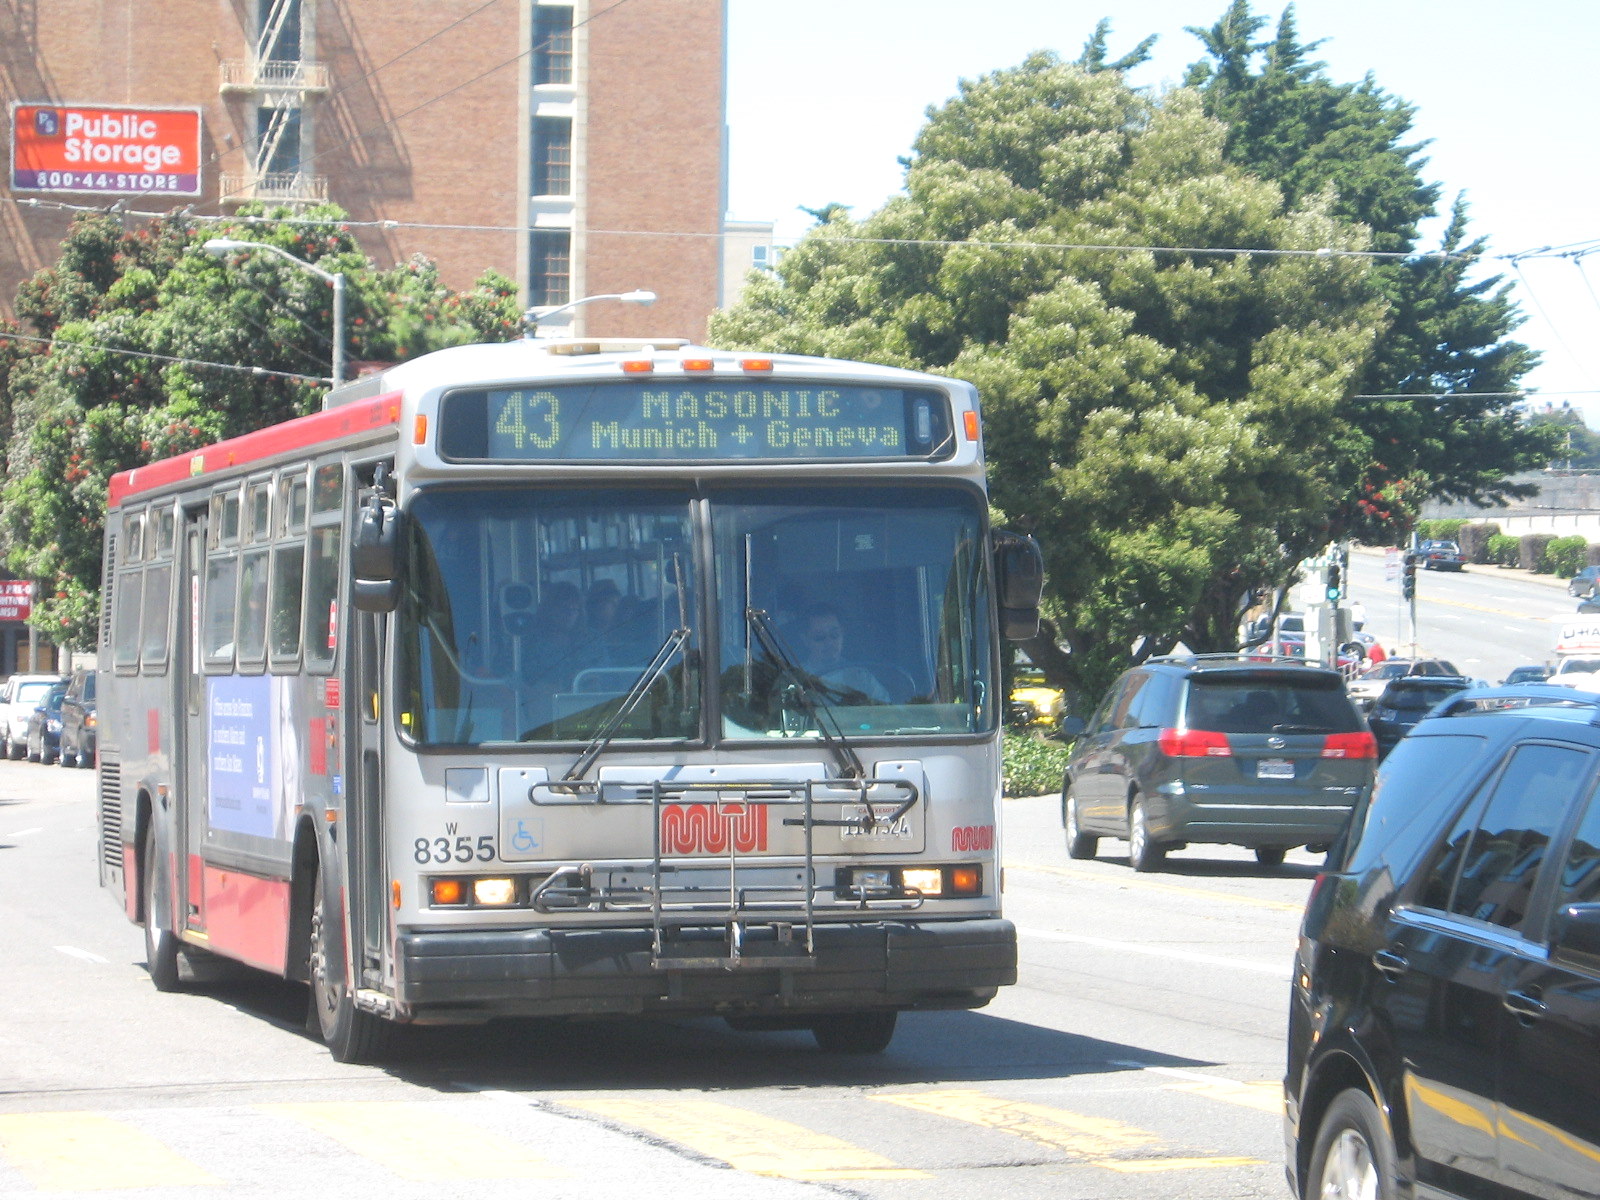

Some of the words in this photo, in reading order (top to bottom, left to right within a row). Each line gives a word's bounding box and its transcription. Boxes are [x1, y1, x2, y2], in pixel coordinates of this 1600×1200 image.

[65, 113, 158, 139] Public
[64, 138, 181, 171] Storage
[641, 390, 841, 418] MASONIC
[495, 391, 562, 449] 43
[591, 421, 718, 449] Munich
[731, 425, 754, 444] +
[766, 420, 899, 448] Geneva
[445, 822, 458, 836] W
[414, 835, 496, 865] 8355
